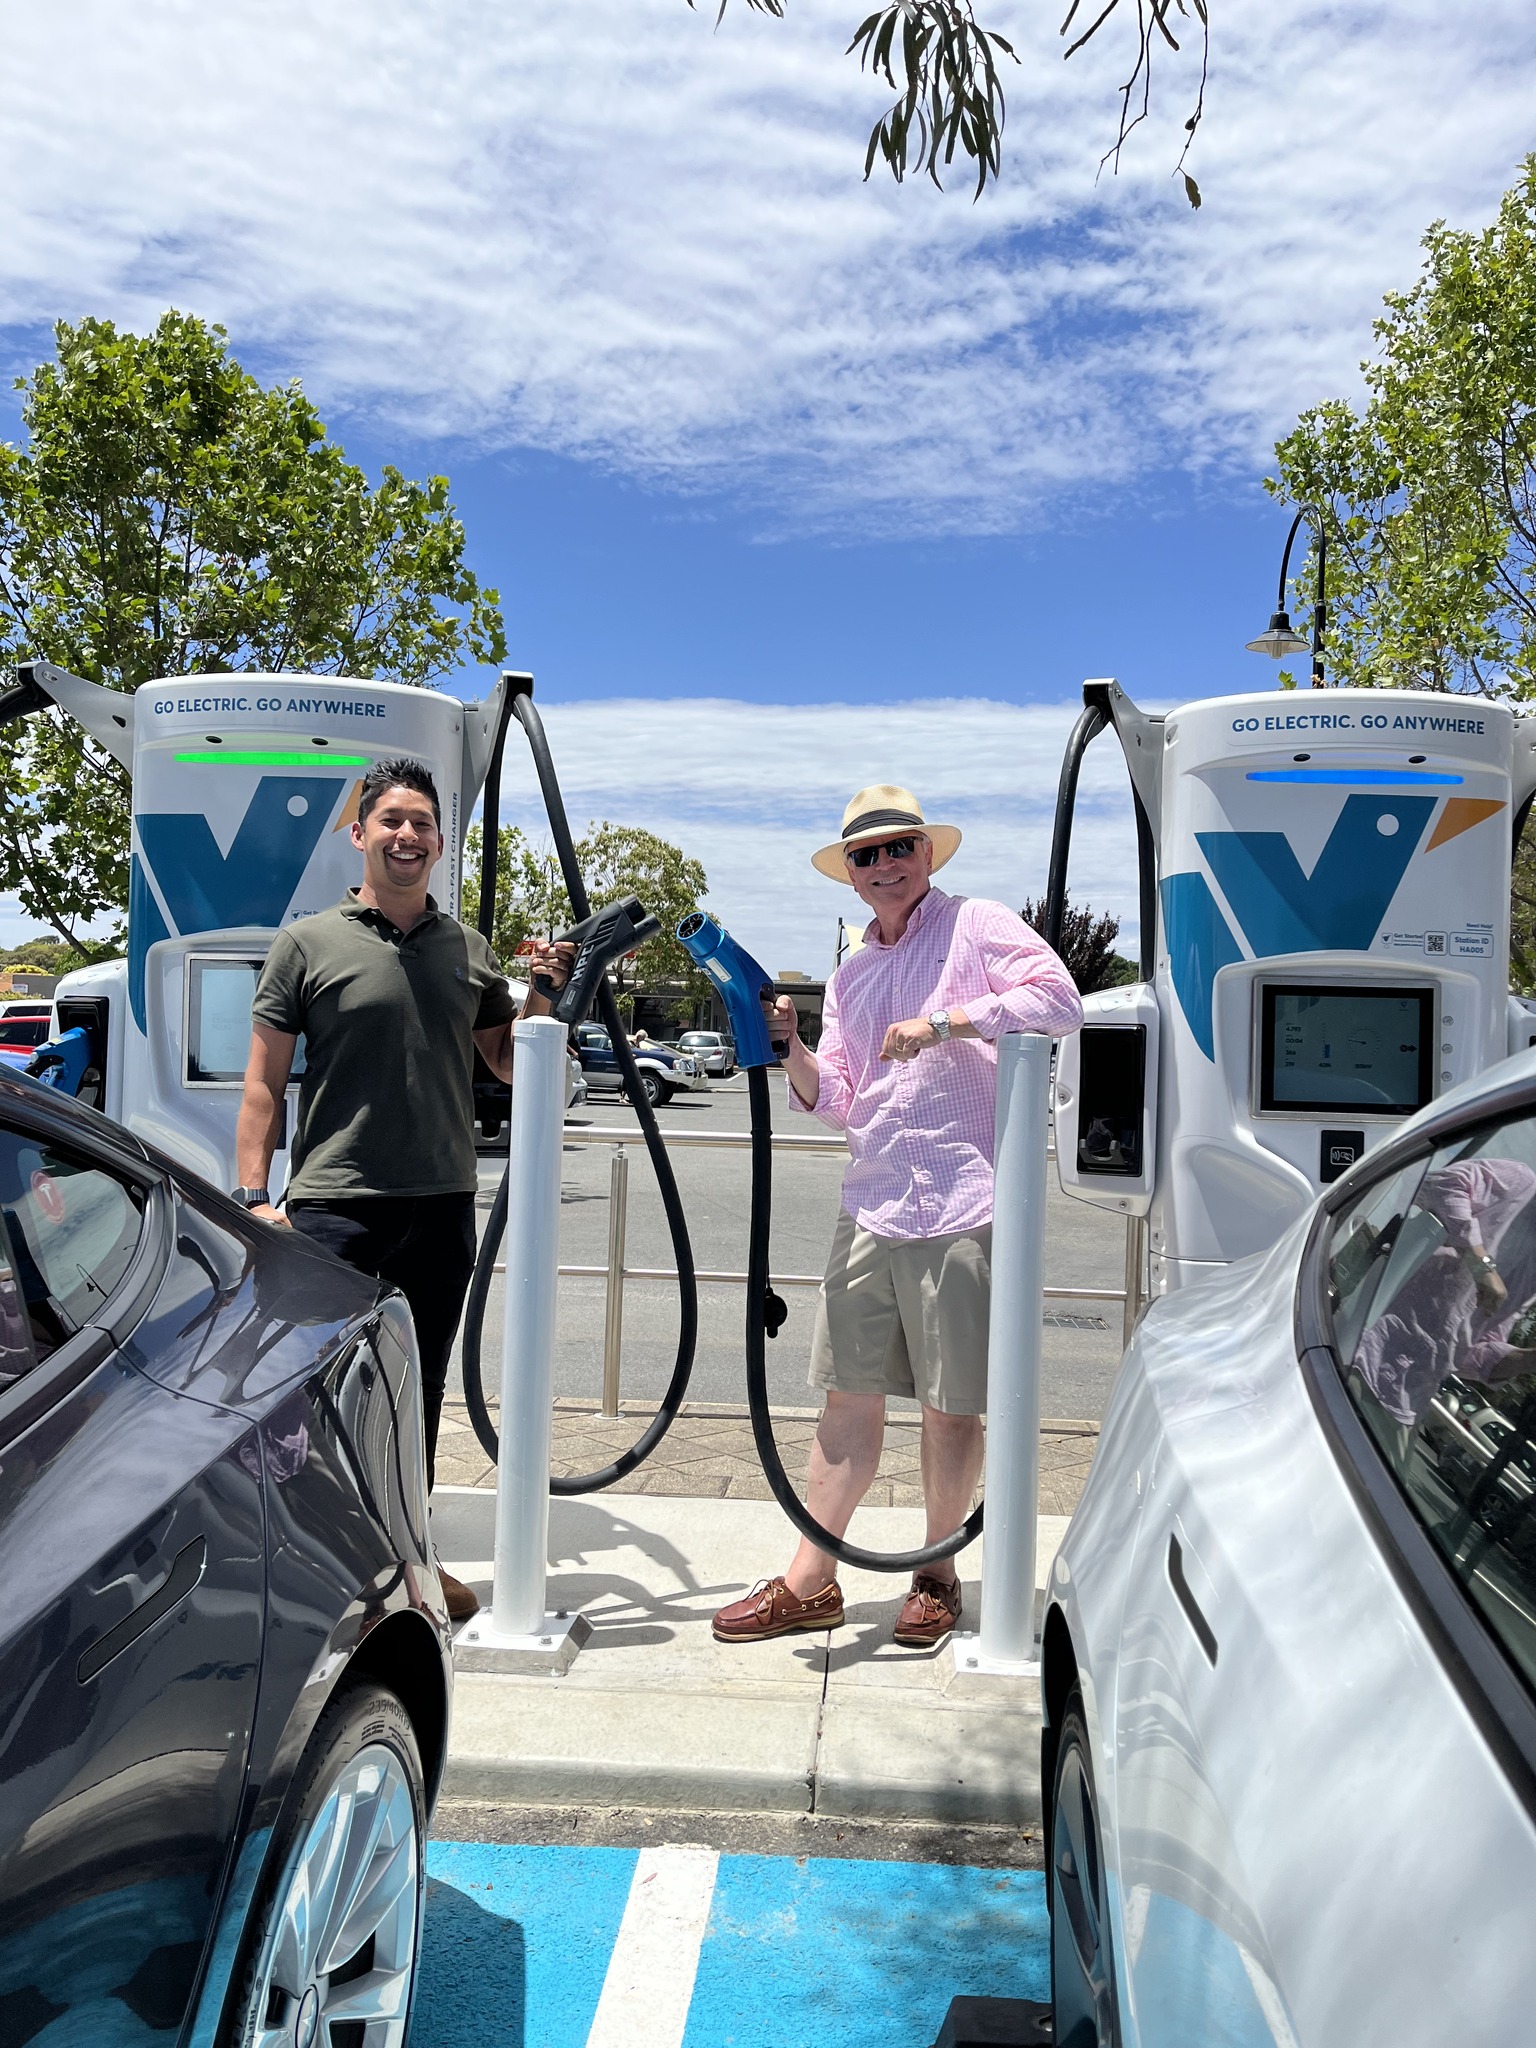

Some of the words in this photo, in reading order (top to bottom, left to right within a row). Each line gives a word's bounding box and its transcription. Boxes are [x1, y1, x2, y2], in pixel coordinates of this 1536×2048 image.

[154, 700, 174, 714] GO
[177, 697, 252, 713] ELECTRIC.
[256, 697, 282, 712] GO
[286, 699, 386, 717] ANYWHERE
[1232, 718, 1260, 732] GO
[1264, 715, 1355, 730] ELECTRIC.
[1360, 715, 1388, 729] GO
[1392, 716, 1485, 735] ANYWHERE
[1454, 936, 1480, 944] Station
[1481, 937, 1489, 945] ID
[571, 944, 594, 982] HPC
